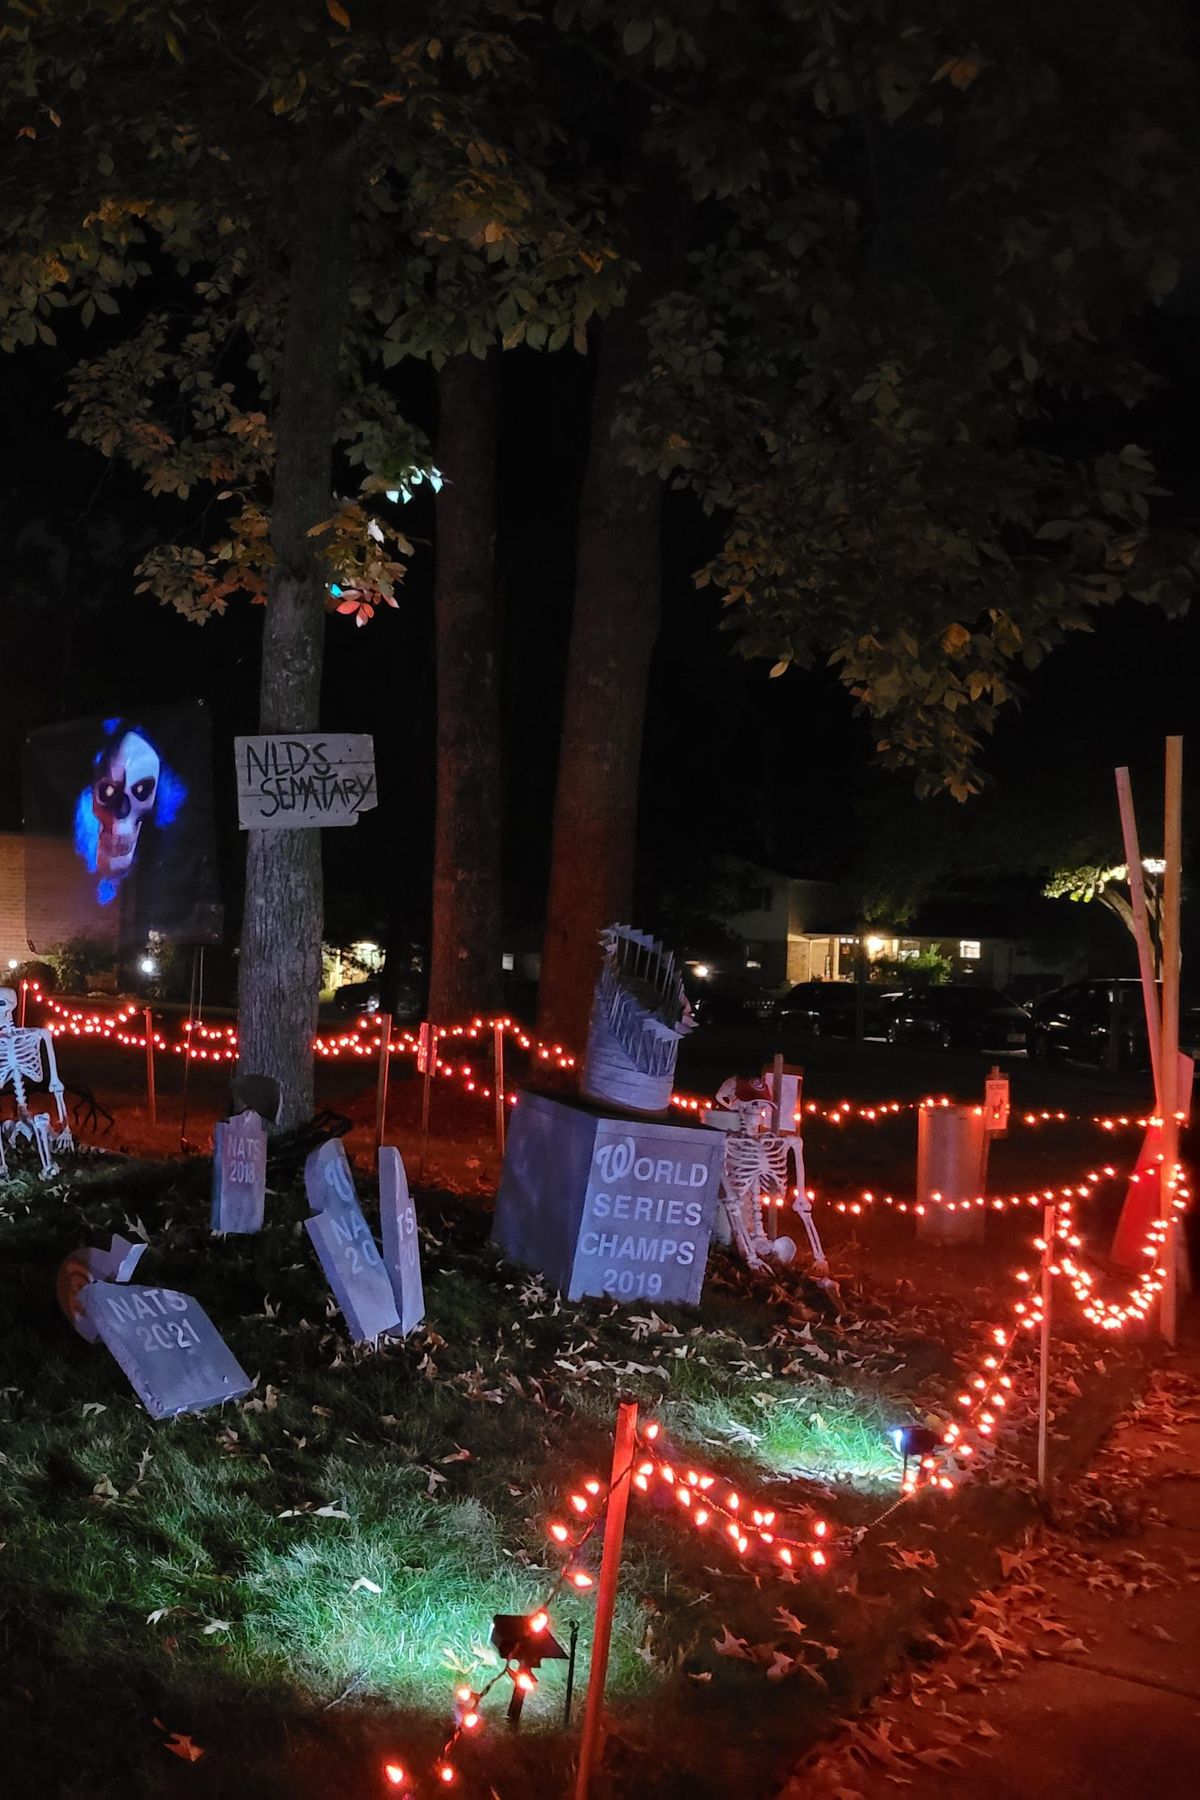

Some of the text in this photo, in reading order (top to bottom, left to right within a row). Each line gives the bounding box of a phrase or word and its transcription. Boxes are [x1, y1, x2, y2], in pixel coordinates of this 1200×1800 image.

[246, 740, 332, 786] NLDS
[591, 1192, 703, 1227] SERIES
[579, 1231, 696, 1266] CHAMPS
[602, 1268, 663, 1297] 2019
